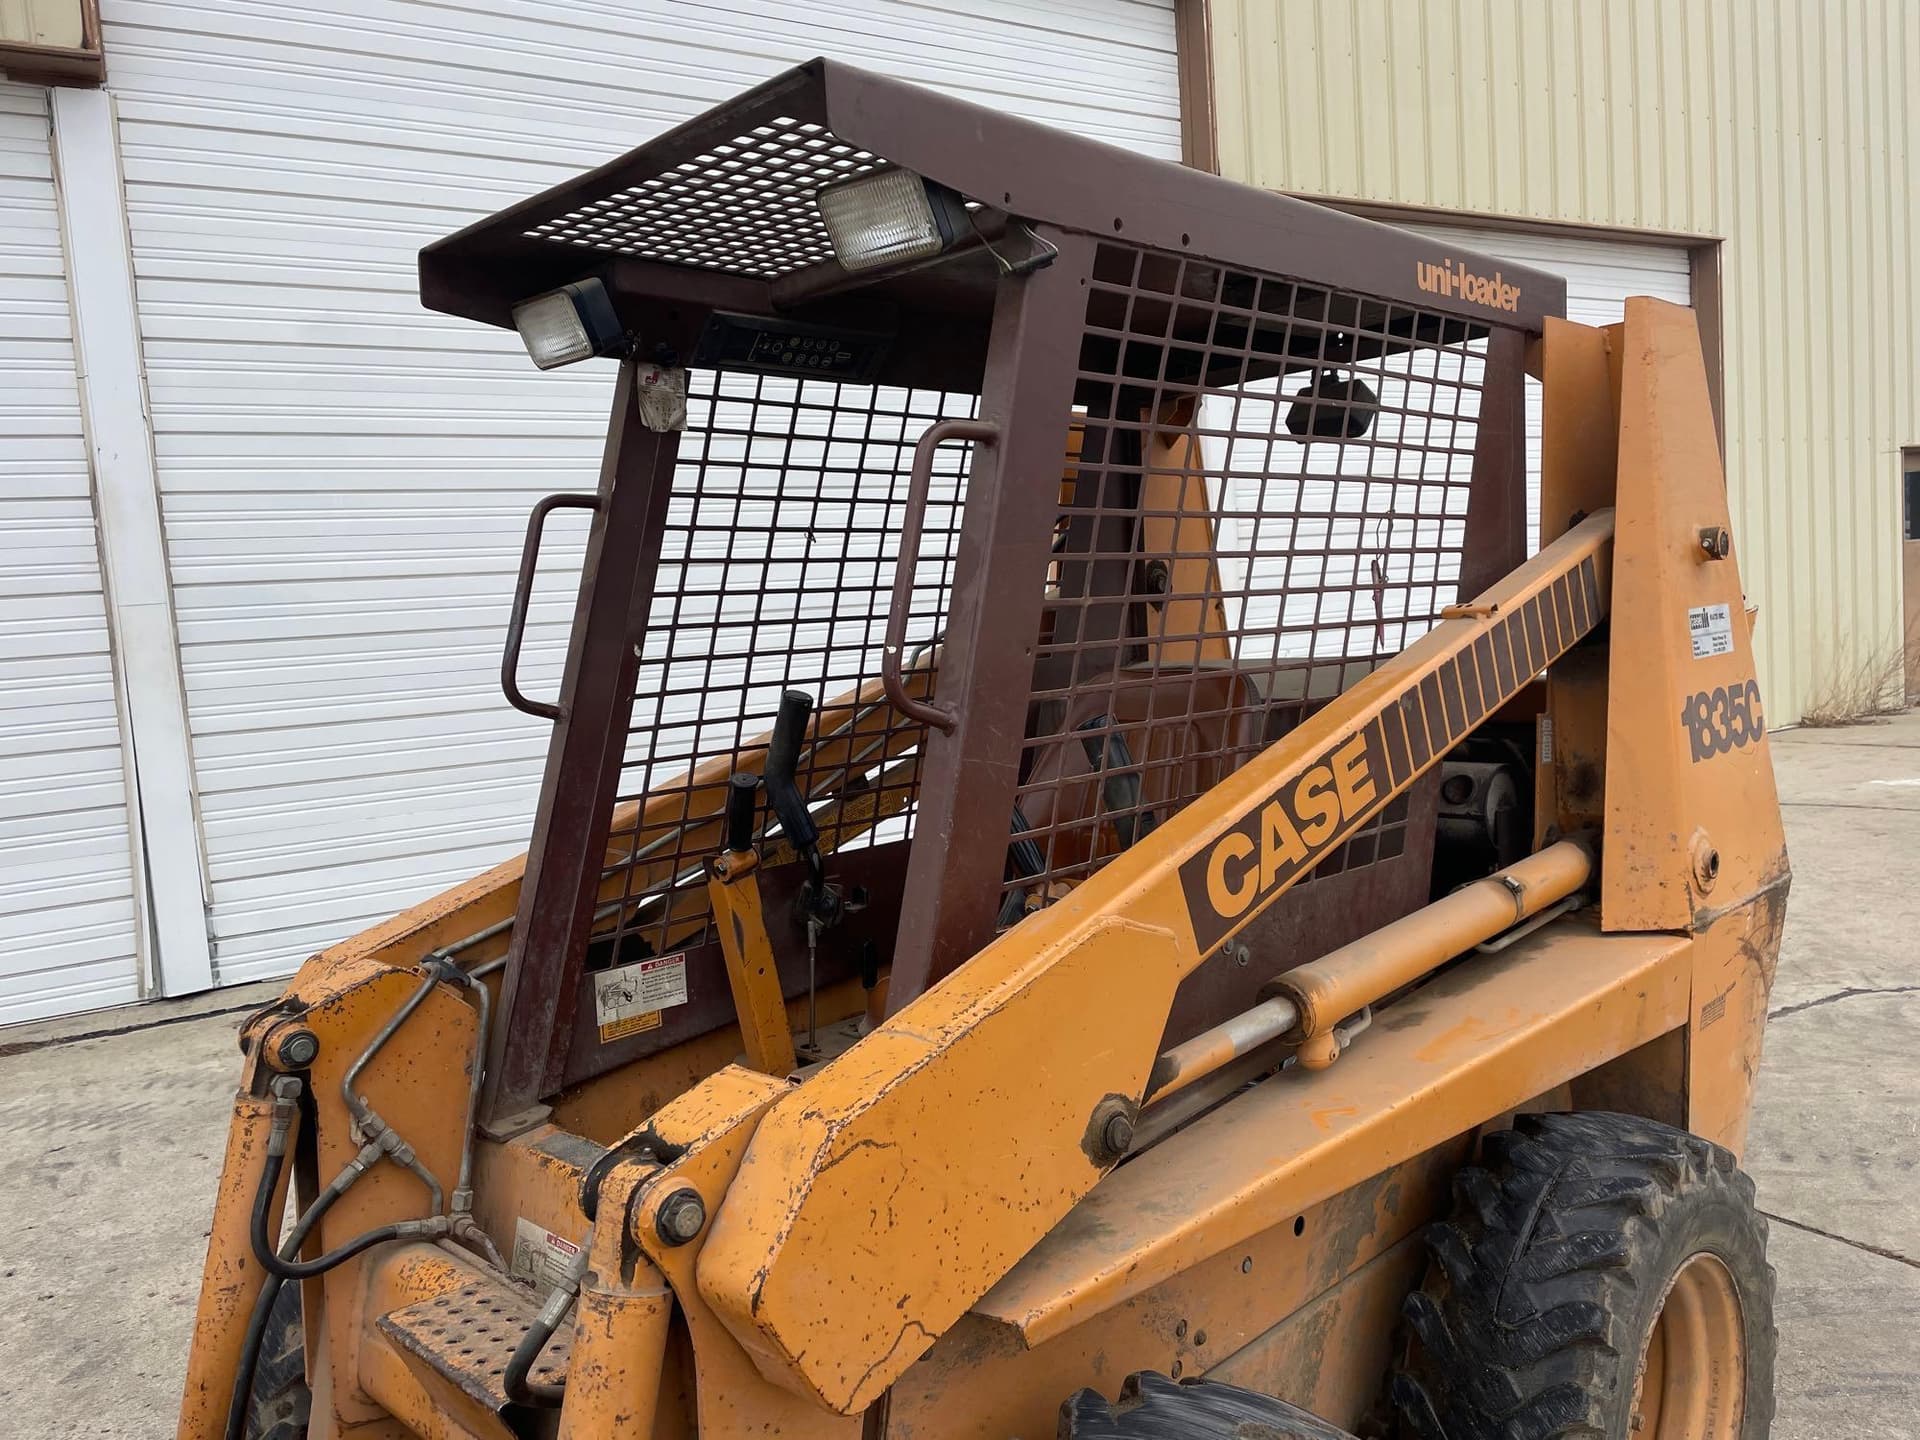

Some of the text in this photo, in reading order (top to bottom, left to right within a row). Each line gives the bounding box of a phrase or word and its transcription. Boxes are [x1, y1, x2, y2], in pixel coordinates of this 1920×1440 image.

[1417, 258, 1521, 312] uni-loader
[1681, 679, 1763, 763] 1835C
[1206, 733, 1377, 918] CASE
[655, 957, 680, 967] DANGER
[556, 1239, 576, 1254] DANGER
